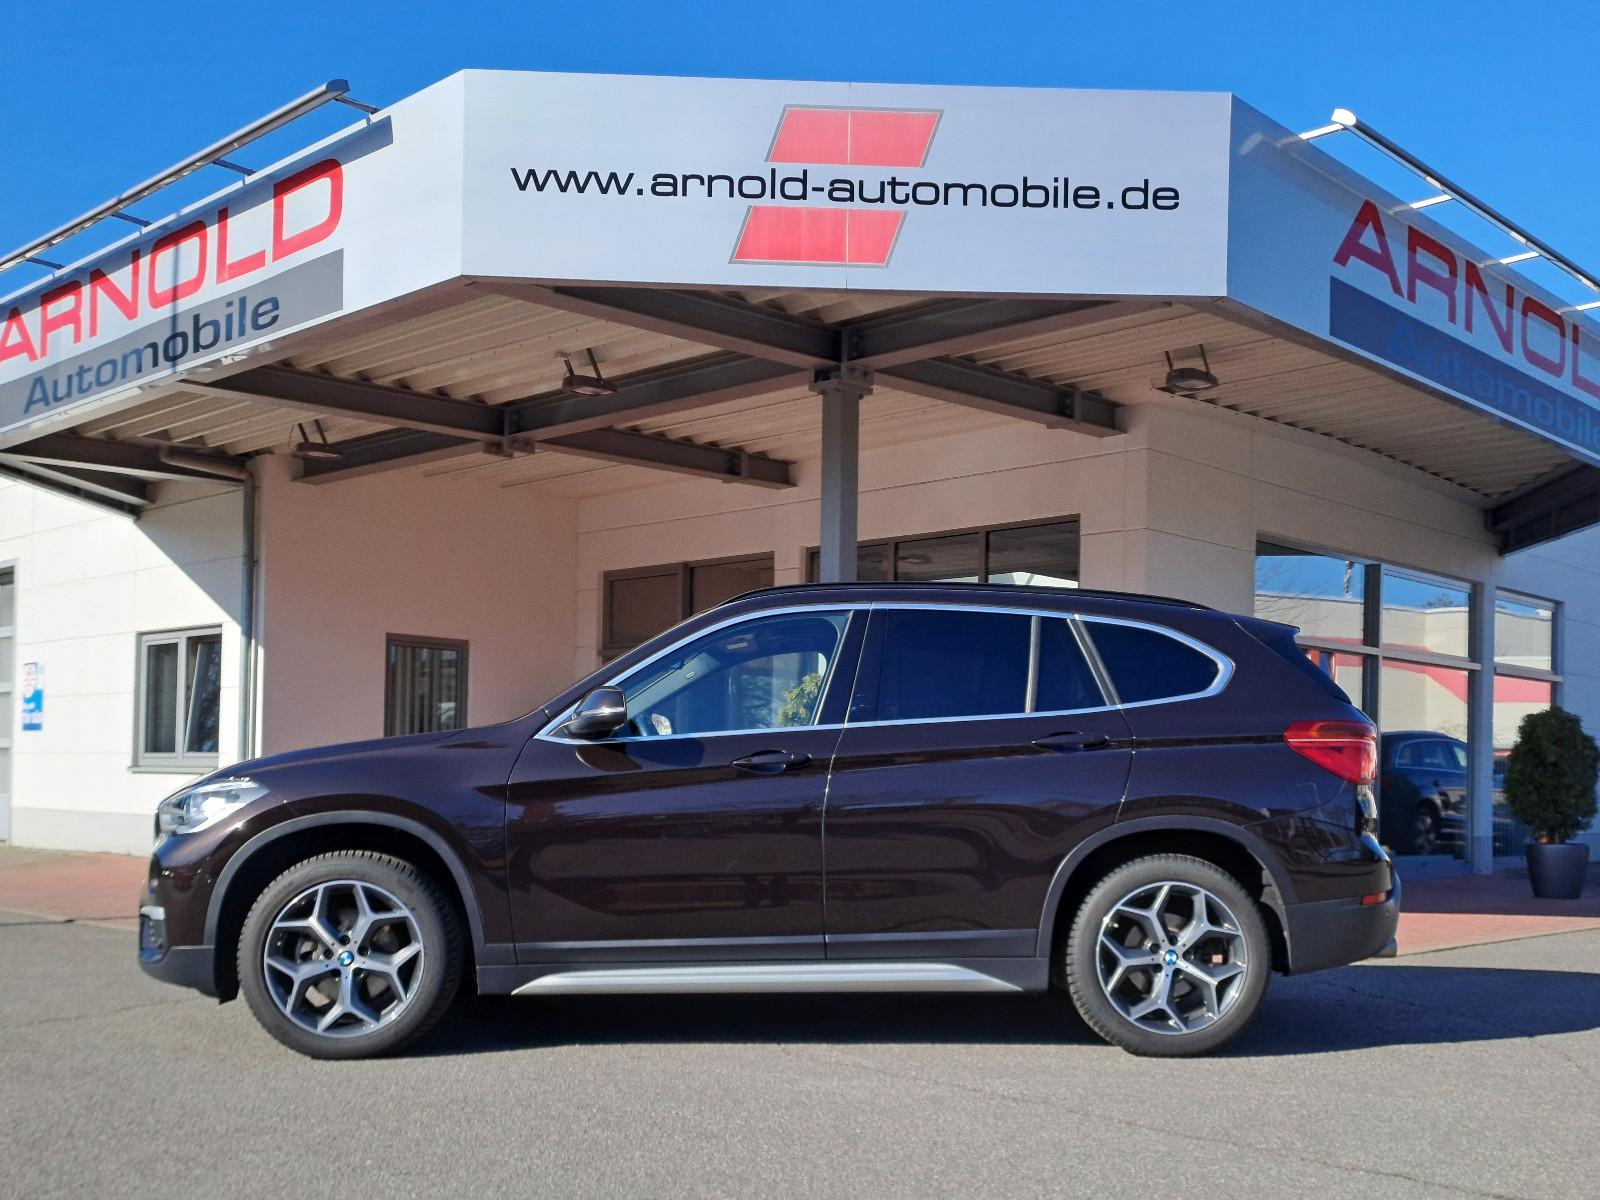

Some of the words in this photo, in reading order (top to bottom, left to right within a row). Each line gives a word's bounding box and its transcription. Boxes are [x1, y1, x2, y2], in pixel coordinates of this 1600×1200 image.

[511, 167, 1180, 210] www.arnold-automobile.de
[0, 158, 344, 362] ARNOLD
[25, 295, 281, 413] Automobile
